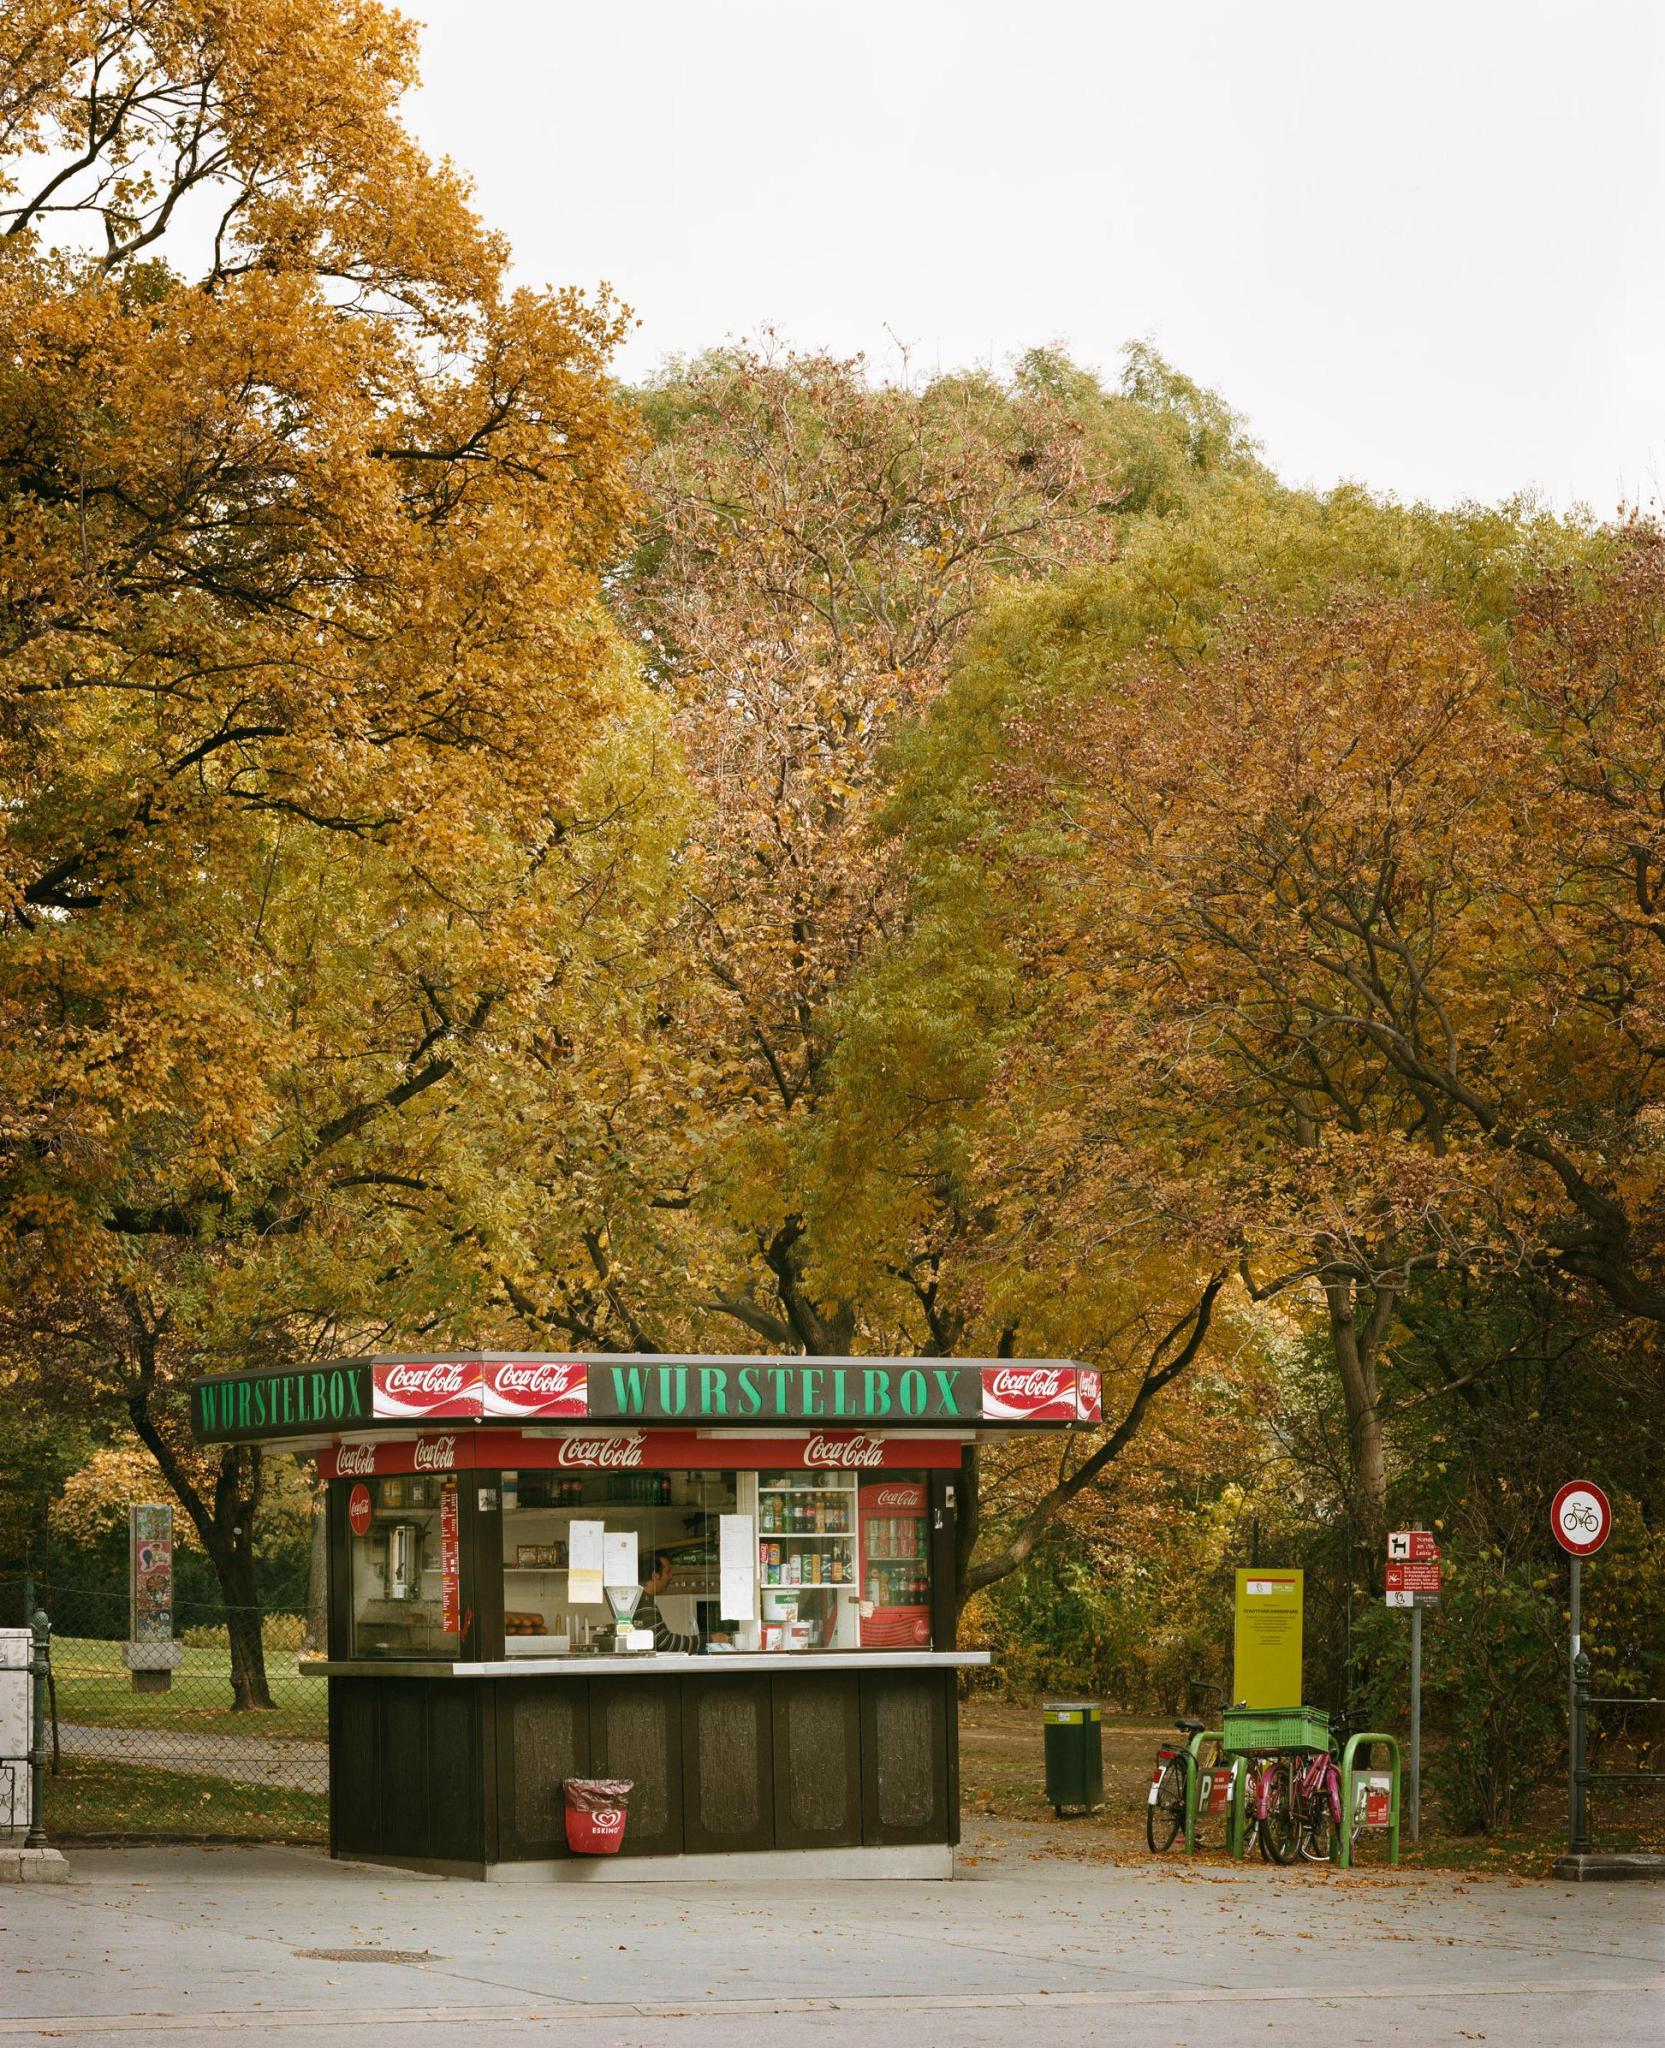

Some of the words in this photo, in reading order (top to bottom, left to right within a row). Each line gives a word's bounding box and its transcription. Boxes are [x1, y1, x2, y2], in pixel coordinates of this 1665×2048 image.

[386, 1363, 468, 1393] Coca-Cola
[494, 1363, 573, 1392] Coca-Cola
[610, 1364, 962, 1416] WÜRSTELBOX
[992, 1369, 1064, 1397] Coca-Cola
[200, 1368, 362, 1432] WÜRSTELBOX
[336, 1442, 376, 1476] Coca-Cola
[414, 1436, 456, 1470] Coca-Cola
[558, 1435, 647, 1467] Coca-Cola
[803, 1435, 885, 1467] Coca-Cola
[877, 1489, 921, 1506] Coca-Cola
